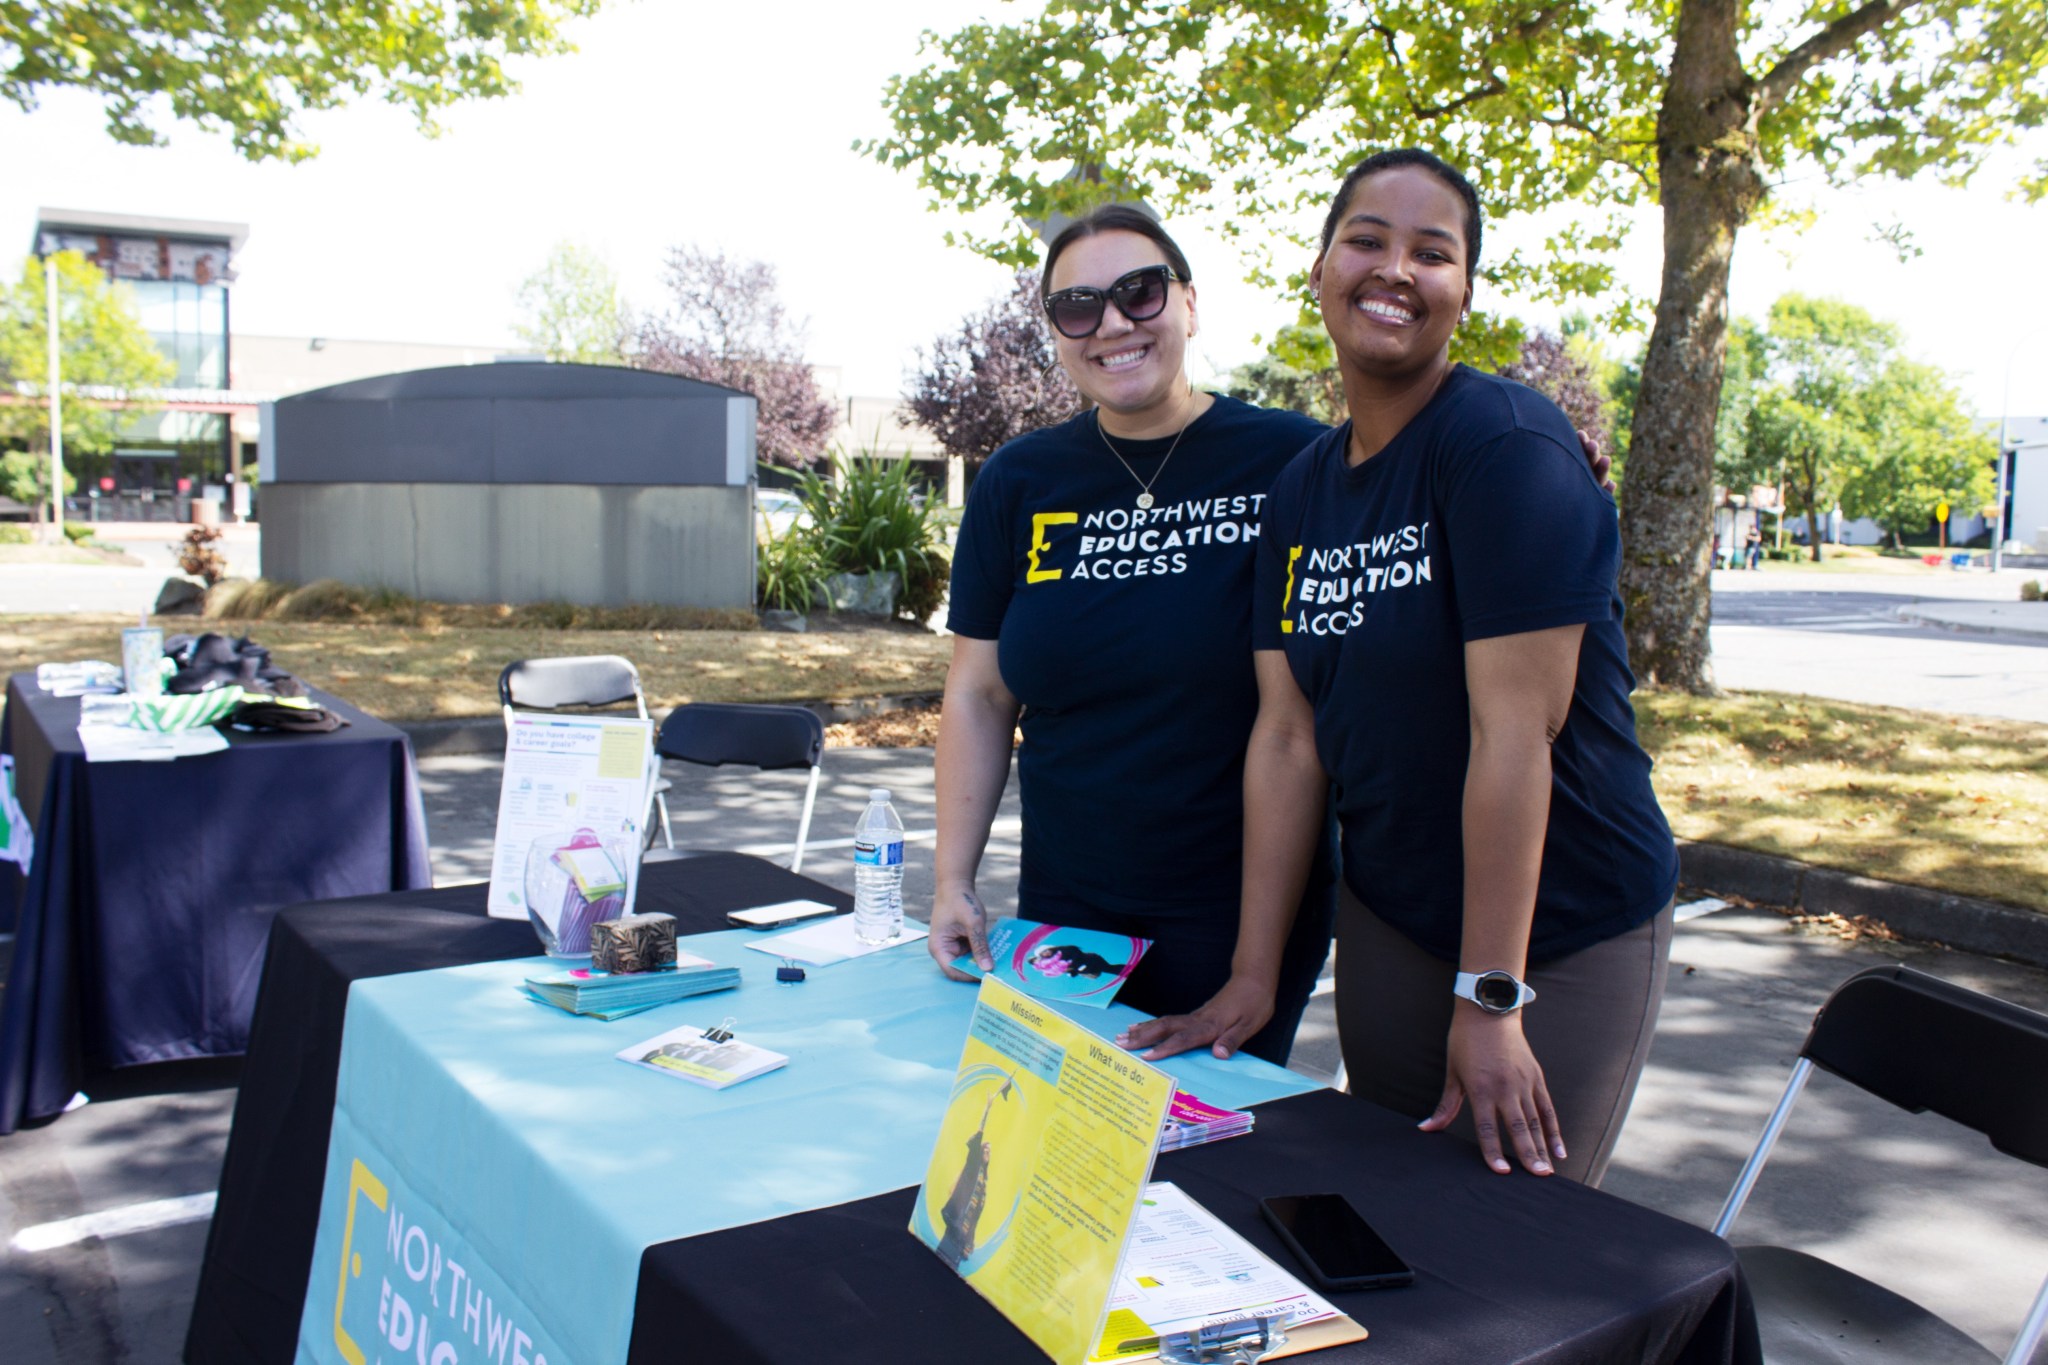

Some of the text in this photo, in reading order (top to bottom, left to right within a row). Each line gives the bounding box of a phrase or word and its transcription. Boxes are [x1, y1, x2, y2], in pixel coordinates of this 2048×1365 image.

[1084, 494, 1266, 531] NORTHWEST
[1079, 521, 1261, 555] EDUCATION
[1070, 553, 1187, 579] ACCESS
[1010, 1001, 1043, 1027] Mission:
[1088, 1045, 1145, 1086] What we do:
[1251, 1304, 1296, 1318] career
[1298, 1306, 1319, 1317] Do
